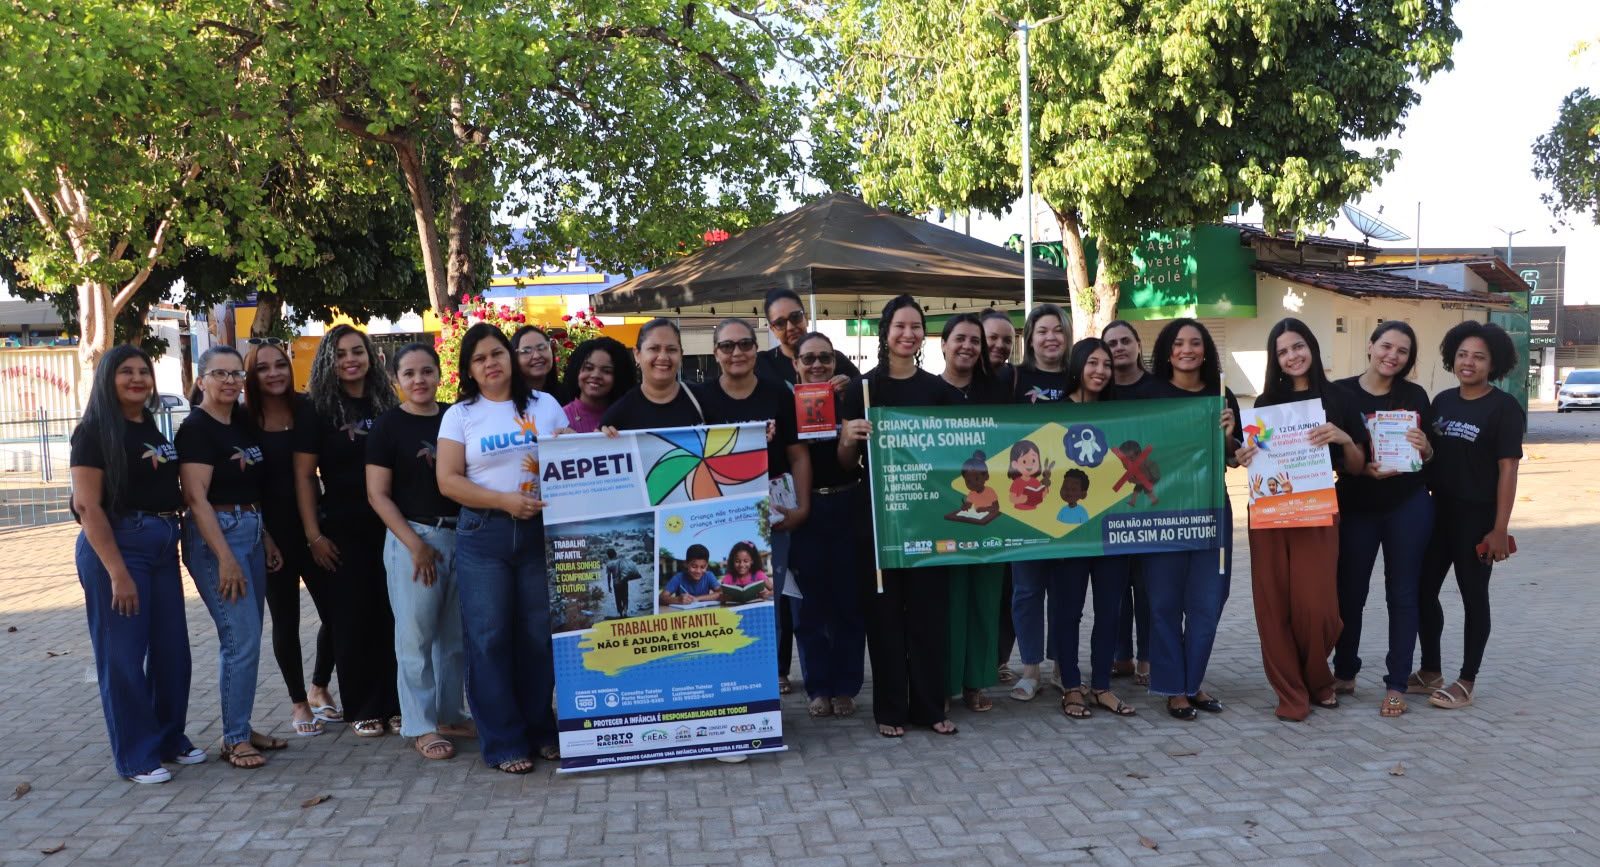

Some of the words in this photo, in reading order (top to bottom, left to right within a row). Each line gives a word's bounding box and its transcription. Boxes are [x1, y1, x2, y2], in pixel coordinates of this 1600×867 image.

[1133, 270, 1181, 286] Picolé
[877, 419, 920, 433] CRIANÇA
[921, 416, 943, 430] NÃO
[944, 417, 998, 430] TRABALHA,
[1297, 421, 1320, 431] JUNHO
[1461, 422, 1480, 434] Junho
[480, 429, 538, 453] NUCA
[879, 433, 935, 451] CRIANÇA
[937, 431, 986, 447] SONHA!
[542, 452, 634, 482] AEPETI
[882, 464, 902, 473] TODA
[902, 463, 933, 473] CRIANÇA
[883, 474, 899, 482] TEM
[900, 472, 927, 482] DIREITO
[890, 481, 925, 492] INFÂNCIA,
[885, 493, 895, 502] AO
[895, 492, 923, 501] ESTUDO
[923, 492, 929, 500] E
[929, 491, 940, 500] AO
[885, 502, 910, 511] LAZER.
[1108, 520, 1125, 529] DIGA
[1126, 517, 1141, 528] NÃO
[1142, 518, 1152, 527] AO
[1153, 517, 1190, 527] TRABALHO
[1109, 531, 1136, 544] DIGA
[1137, 529, 1158, 542] SIM
[1160, 528, 1175, 541] AO
[553, 539, 586, 550] TRABALHO
[554, 550, 582, 561] INFANTIL
[555, 562, 576, 572] ROUBA
[576, 560, 601, 570] SONHOS
[556, 585, 562, 594] O
[562, 583, 586, 593] FUTURO
[611, 617, 668, 637] TRABALHO
[670, 612, 720, 631] INFANTIL
[597, 639, 620, 650] NÃO
[623, 639, 629, 647] É
[632, 635, 670, 645] AJUDA,
[672, 633, 679, 641] É
[681, 626, 734, 639] VIOLAÇÃO
[633, 647, 648, 655] DE
[650, 640, 700, 652] DIREITOS!
[593, 717, 624, 727] PROTEGER
[629, 714, 657, 724] INFÂNCIA
[657, 712, 661, 721] É
[661, 710, 717, 721] RESPONSABILIDADE
[717, 708, 726, 716] DE
[727, 705, 748, 714] TODOS!
[596, 732, 634, 742] PORTO
[642, 732, 668, 741] CREAS
[597, 739, 633, 747] NACIONAL
